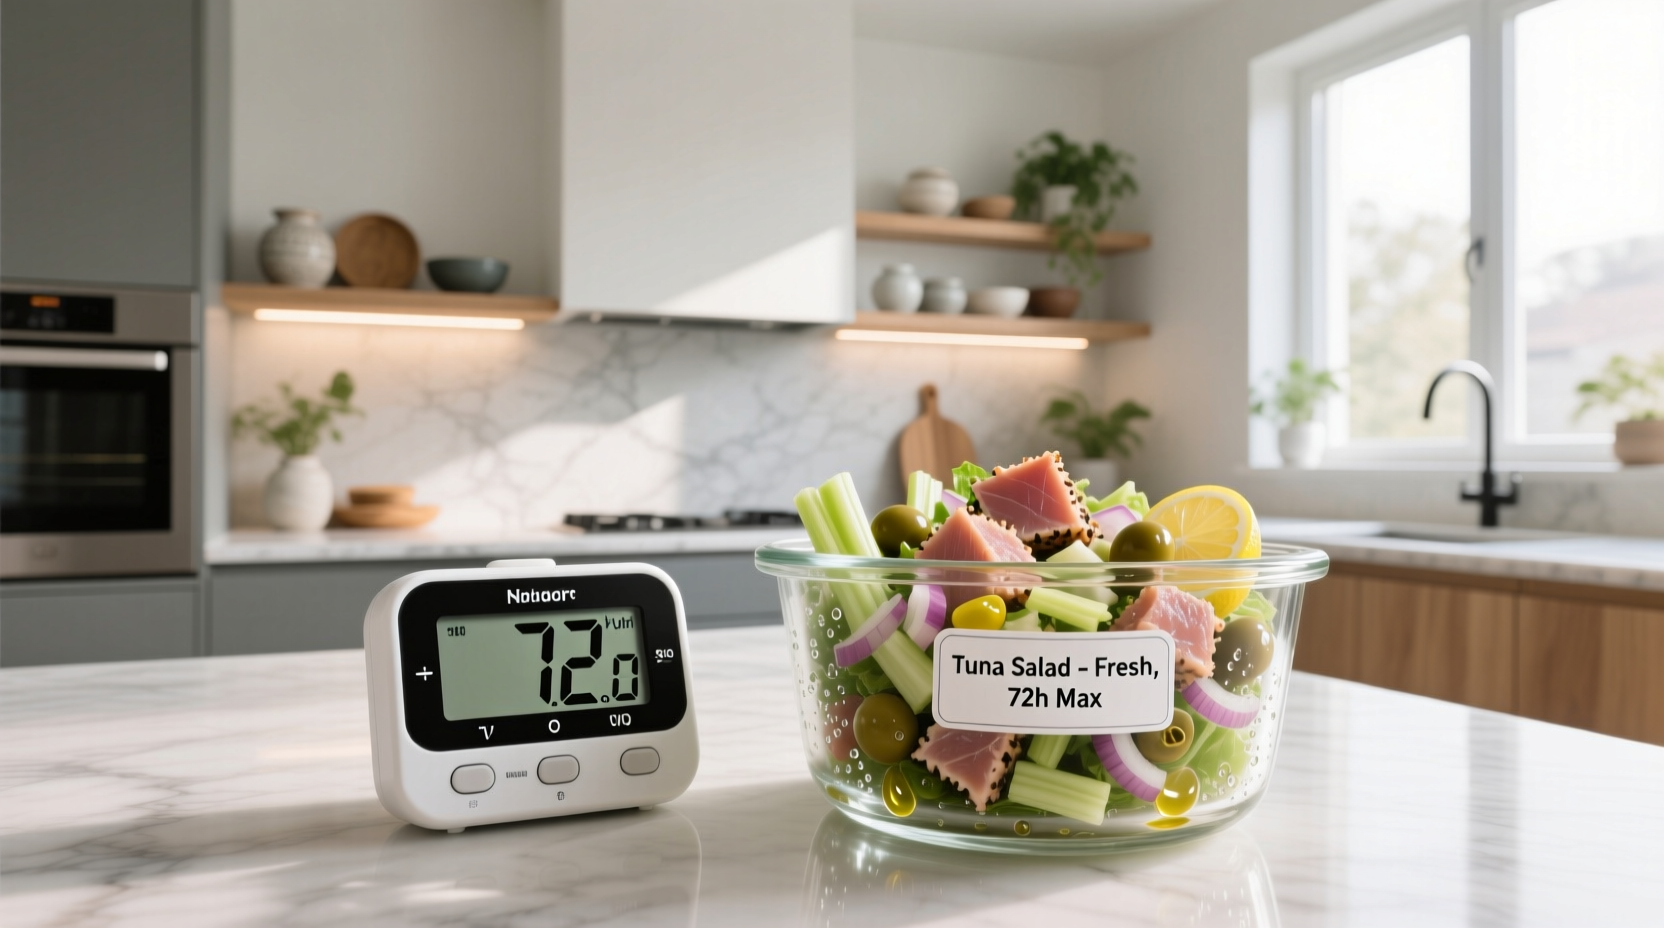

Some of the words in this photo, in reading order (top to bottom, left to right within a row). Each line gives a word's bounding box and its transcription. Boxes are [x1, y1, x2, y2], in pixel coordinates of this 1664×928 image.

[951, 654, 1005, 676] Tuna
[1011, 656, 1071, 678] Salad
[1095, 656, 1159, 680] Fresh,
[1007, 687, 1049, 708] 72h
[1056, 688, 1103, 708] Max
